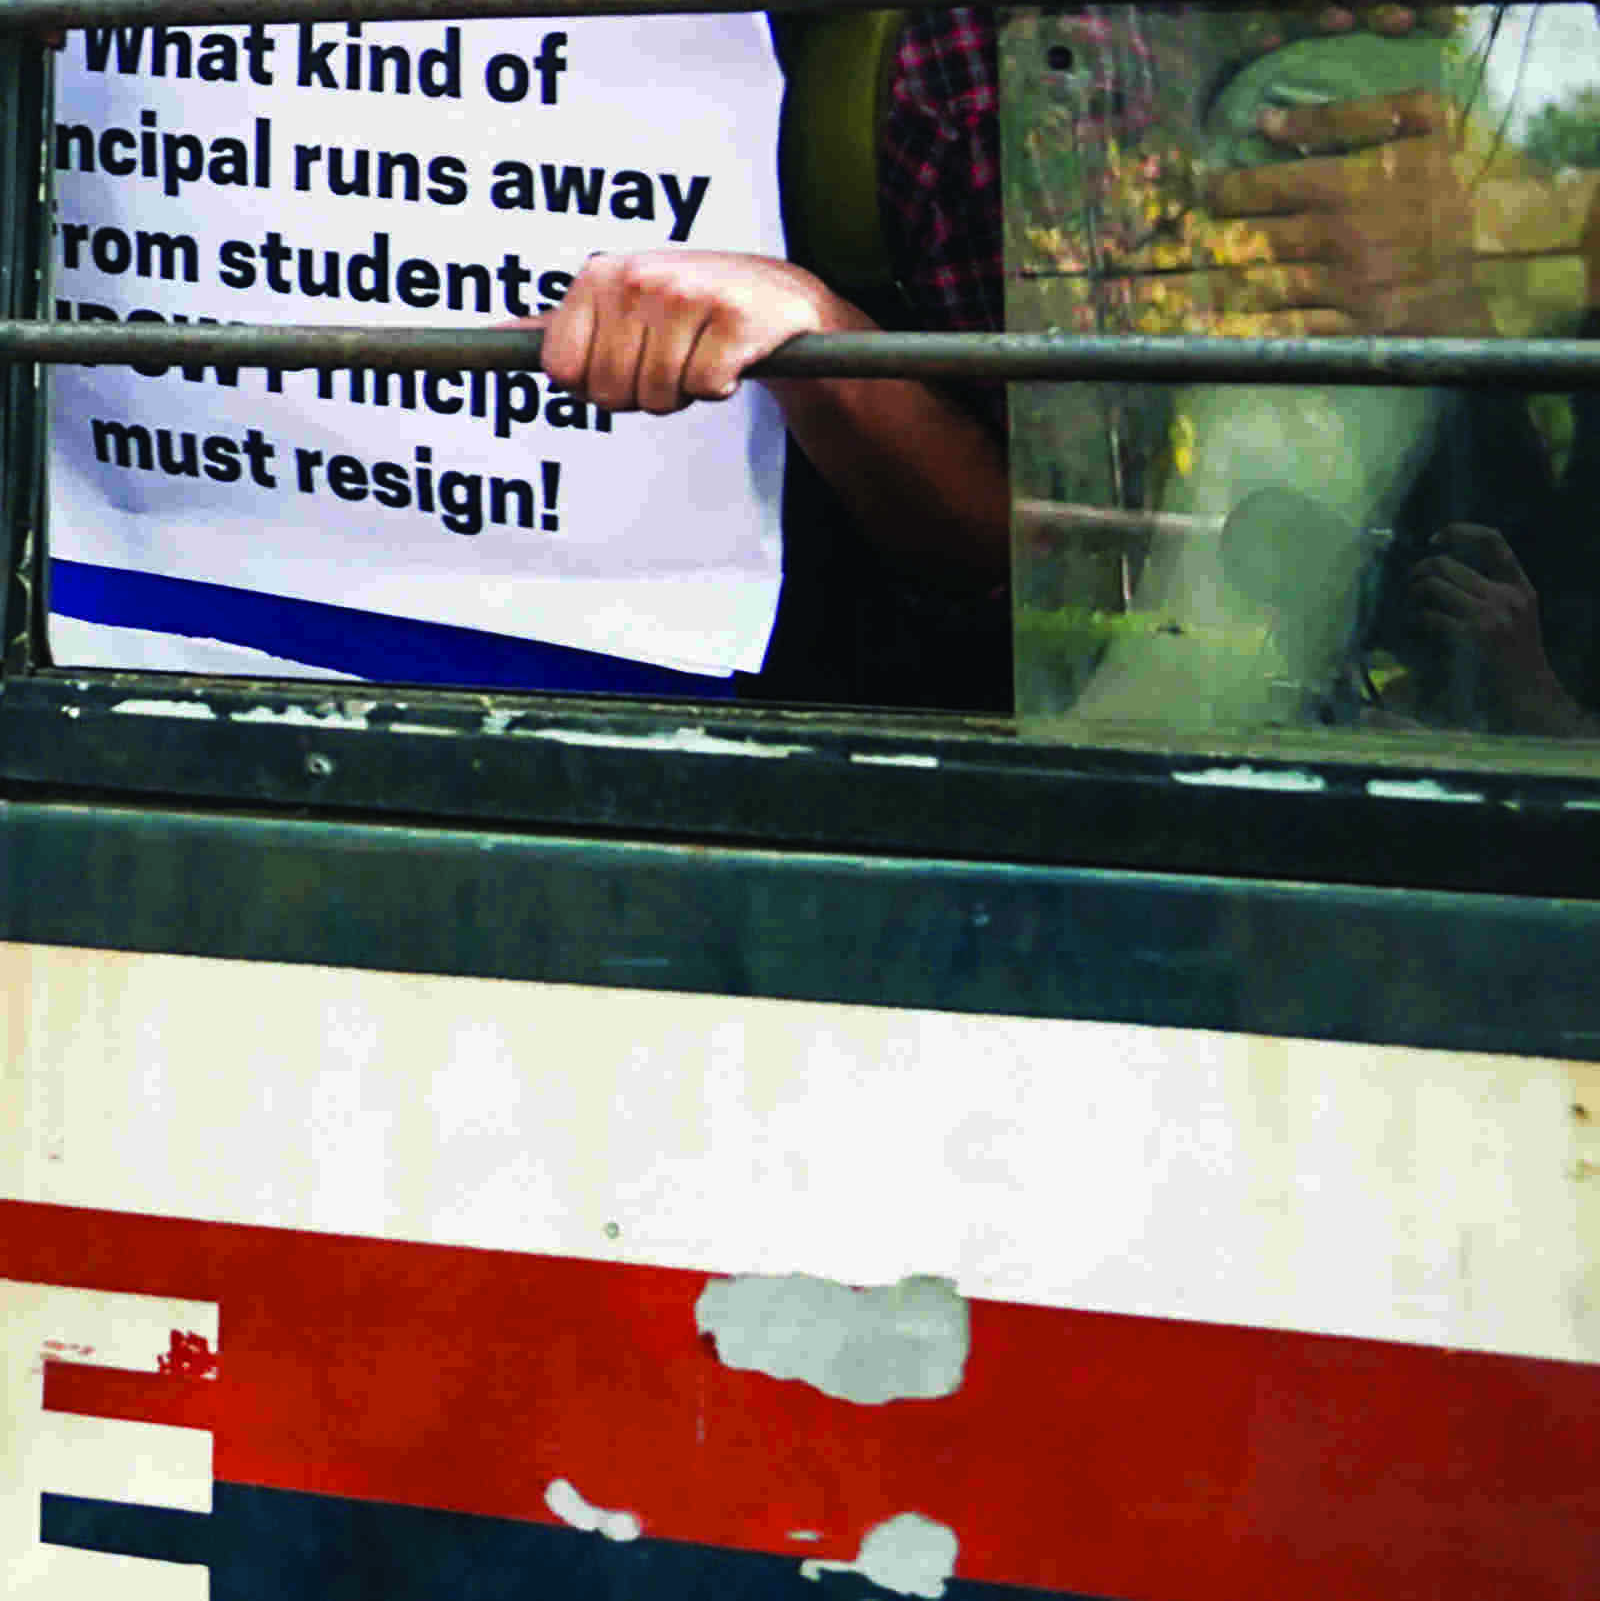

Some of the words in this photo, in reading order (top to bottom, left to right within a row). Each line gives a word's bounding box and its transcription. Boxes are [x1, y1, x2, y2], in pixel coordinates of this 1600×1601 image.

[84, 22, 275, 86] What
[295, 20, 462, 99] kind
[483, 31, 568, 107] of
[55, 109, 272, 197] ncipal
[293, 139, 468, 205] runs
[490, 158, 711, 243] away
[53, 207, 200, 283] rom
[218, 232, 578, 320] students
[90, 417, 277, 490] must
[297, 445, 563, 536] resign!
